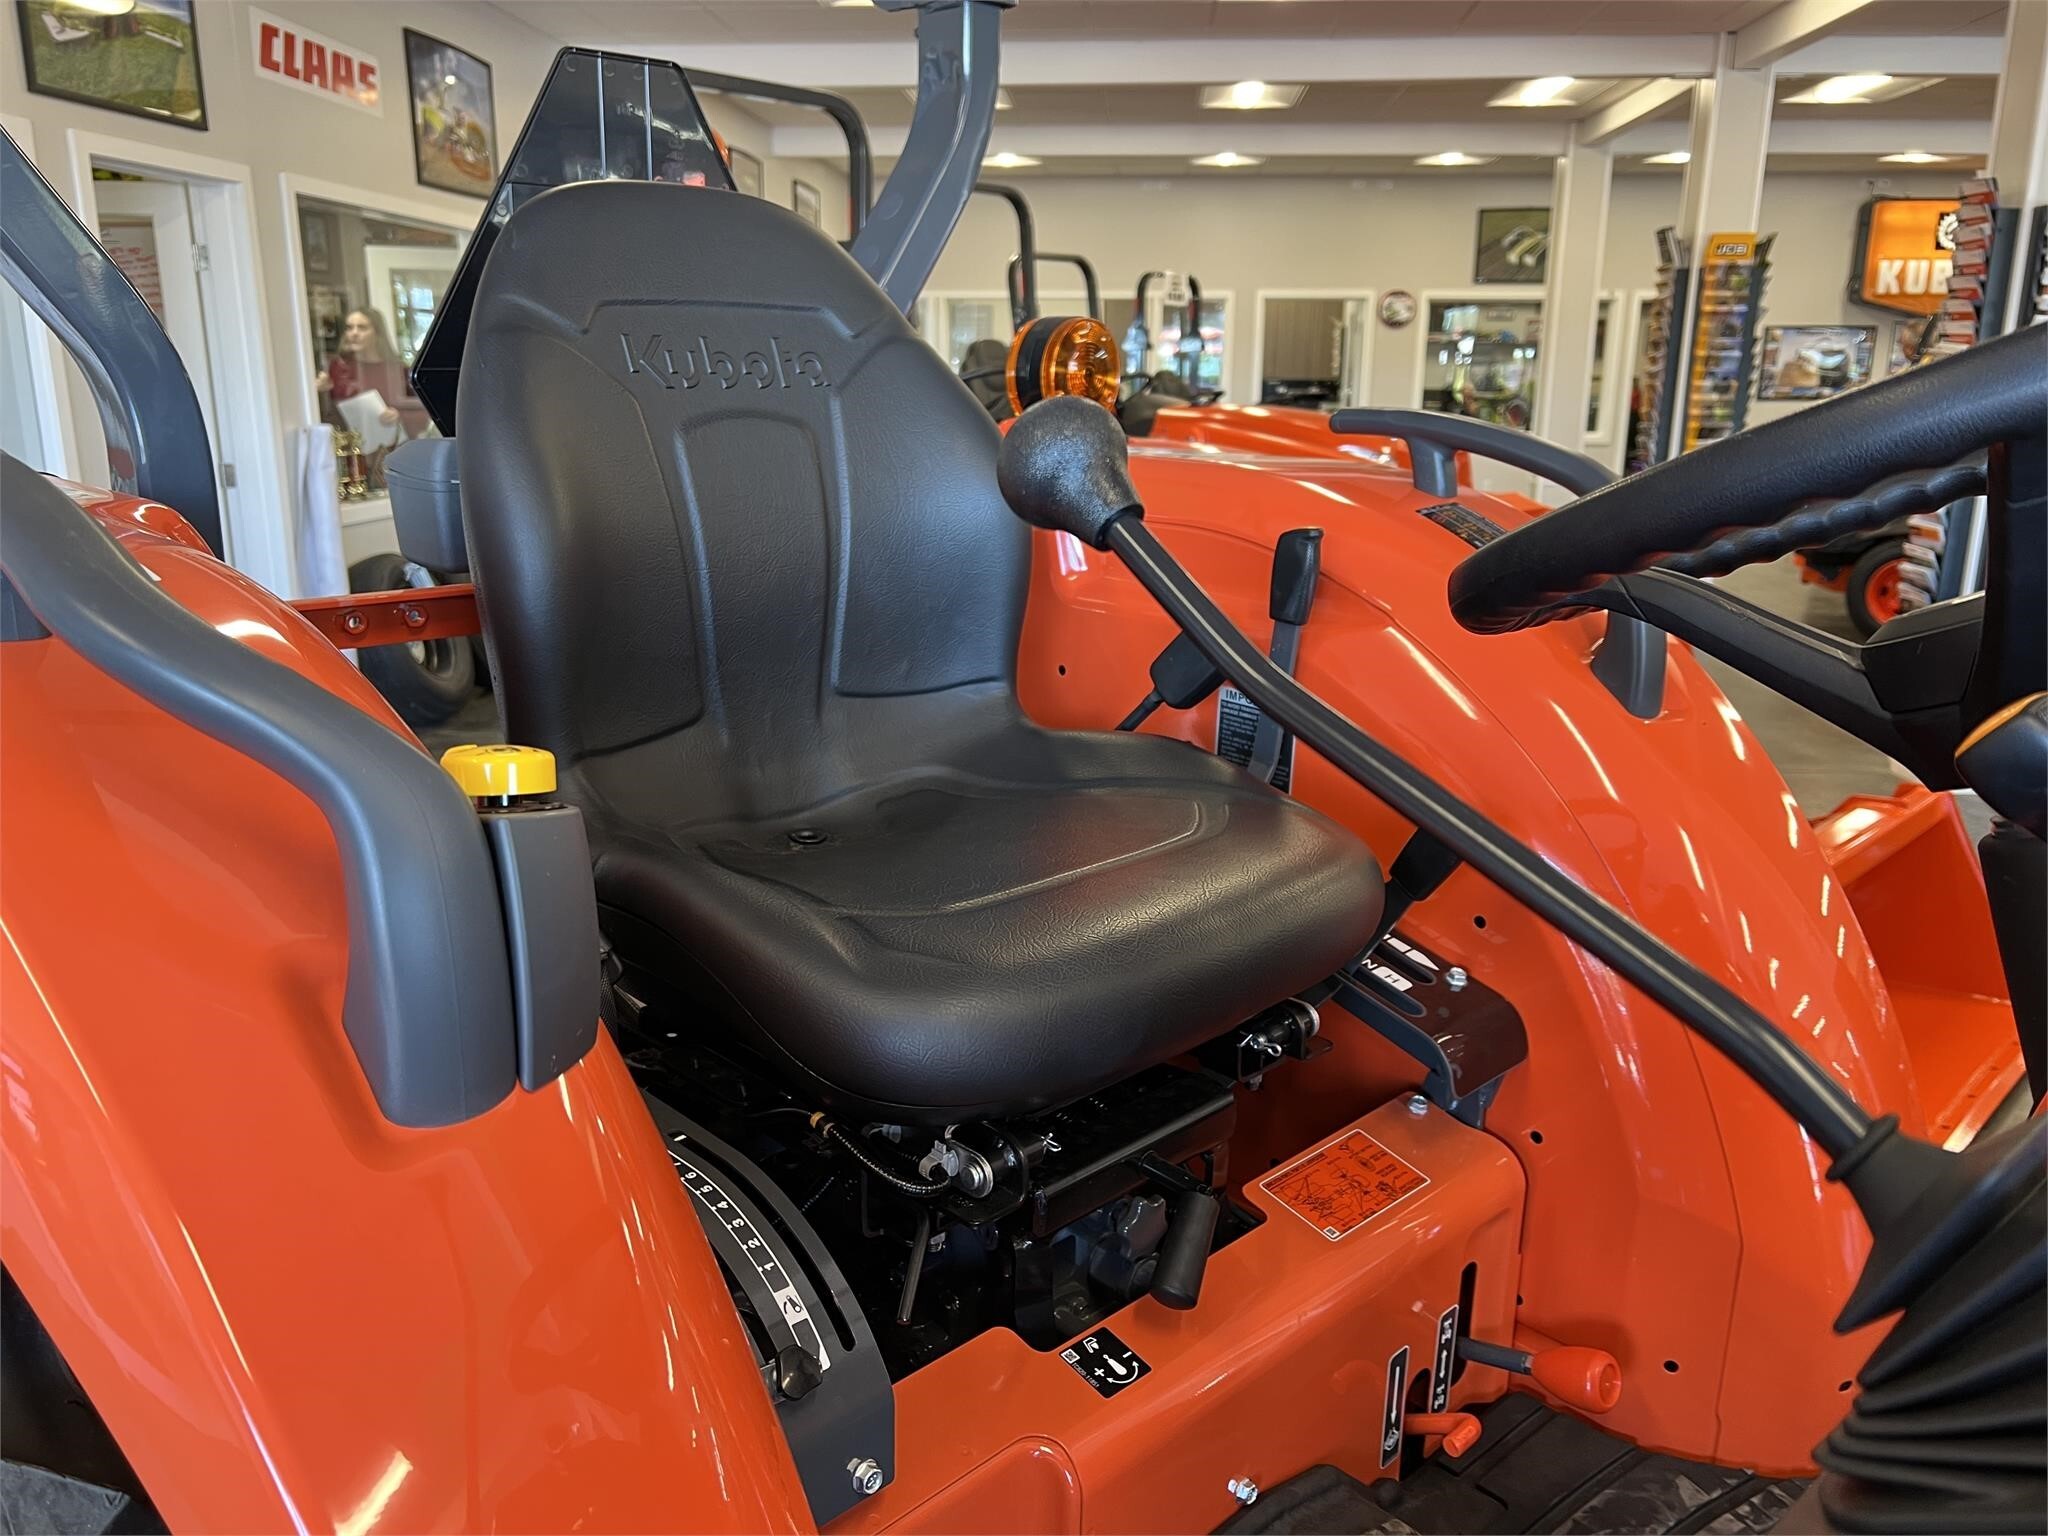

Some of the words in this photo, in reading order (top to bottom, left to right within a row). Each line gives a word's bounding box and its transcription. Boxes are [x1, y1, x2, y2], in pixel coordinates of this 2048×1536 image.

[260, 22, 378, 106] CLAAS
[1875, 258, 1954, 295] KUB
[620, 333, 832, 390] Kubota
[684, 1171, 697, 1179] 6
[700, 1185, 713, 1193] 5
[717, 1201, 729, 1209] 4
[732, 1218, 745, 1228] 3
[747, 1237, 761, 1248] 2
[763, 1262, 775, 1271] 1
